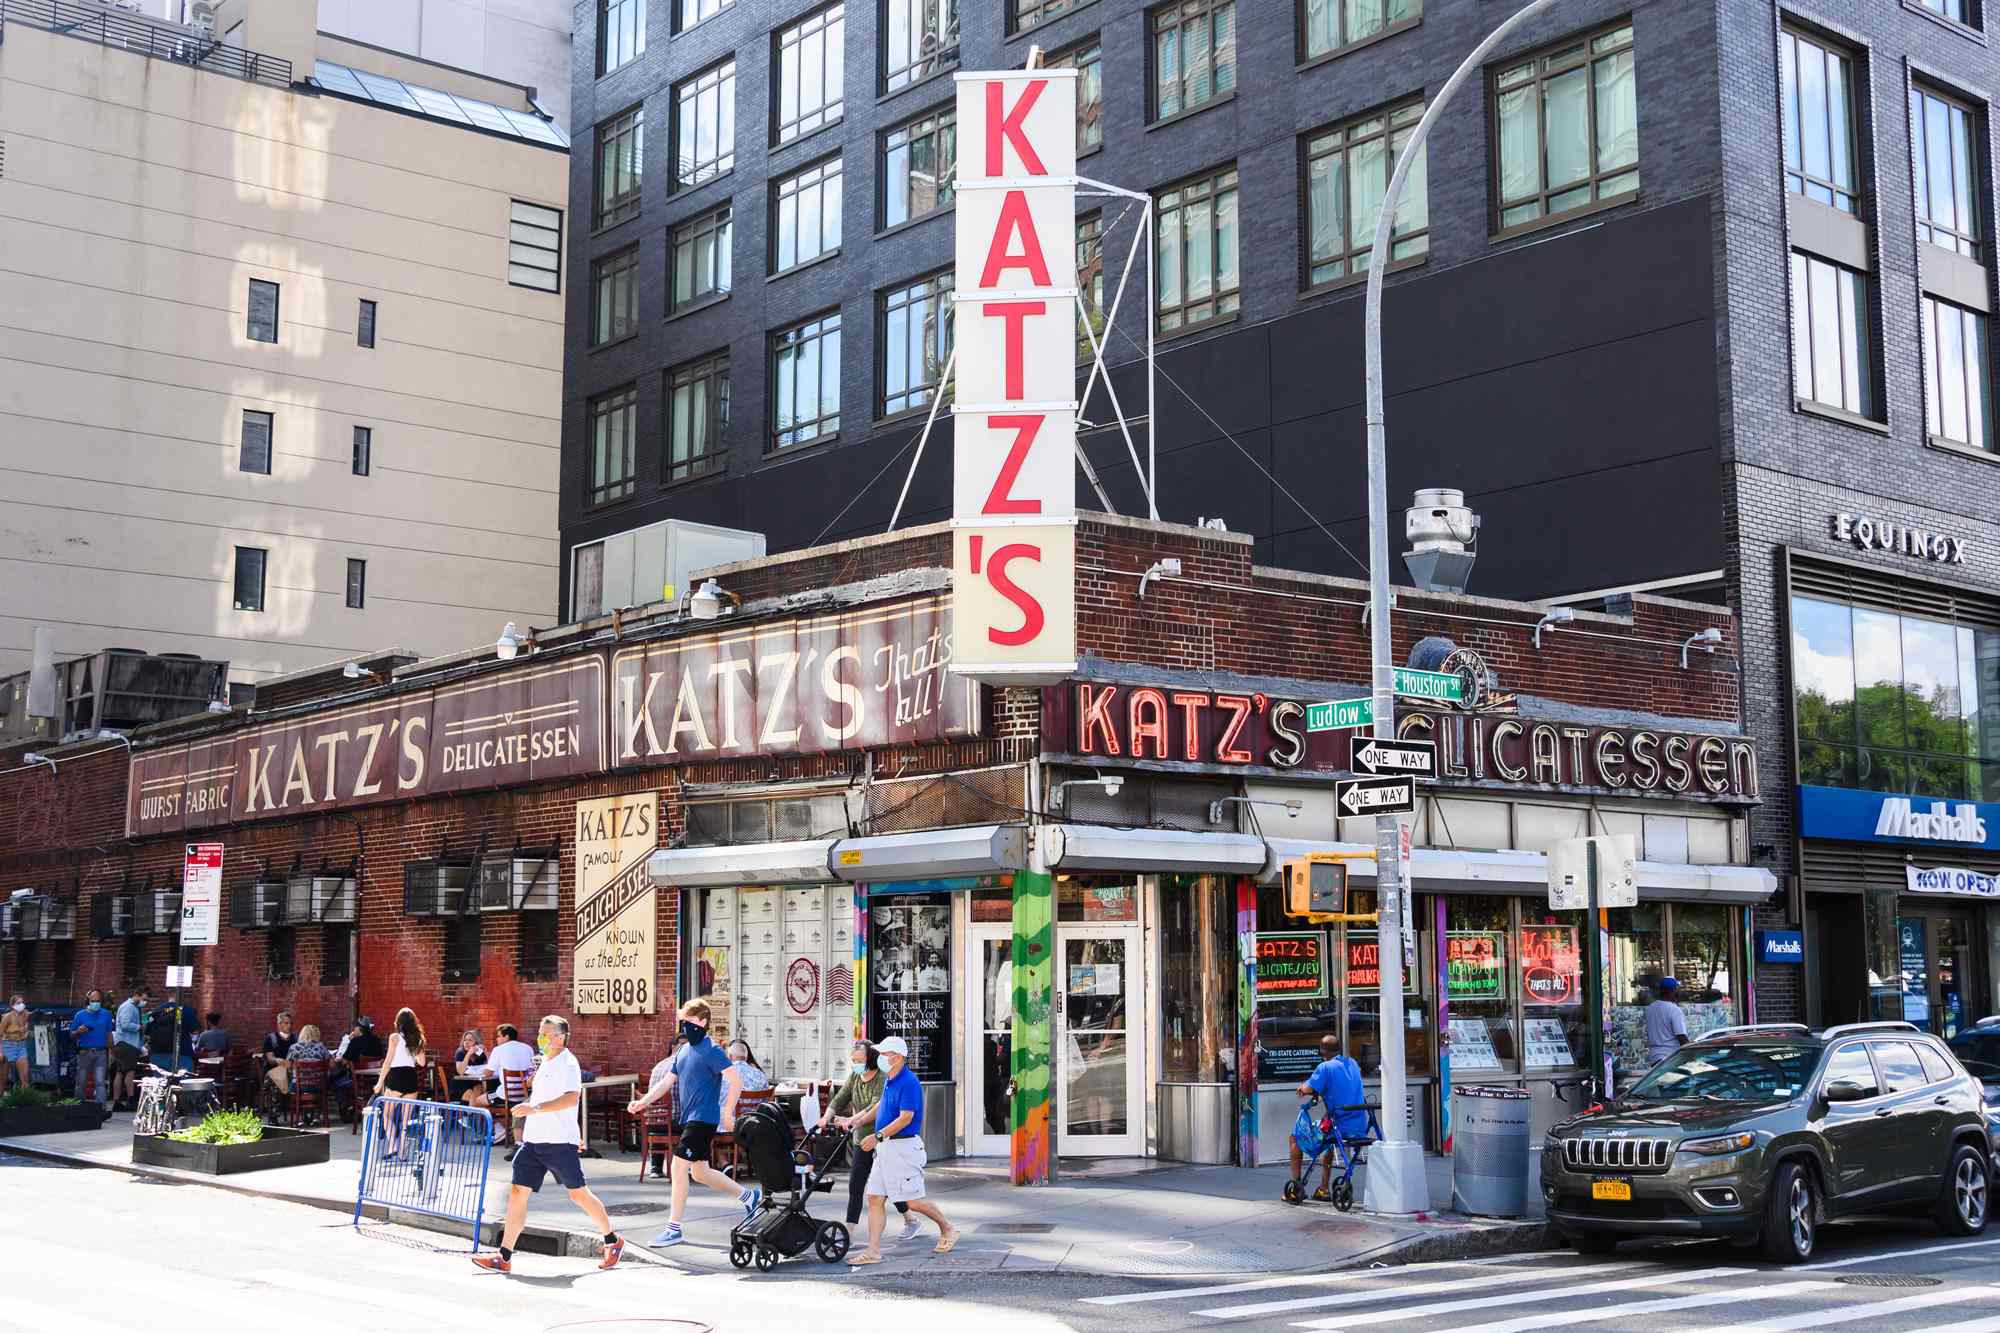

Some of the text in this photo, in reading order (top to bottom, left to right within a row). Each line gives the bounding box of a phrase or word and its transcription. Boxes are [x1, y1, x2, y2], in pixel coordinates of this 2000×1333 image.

[969, 80, 1053, 647] KATZ'S
[1835, 512, 1967, 564] EQUINOX
[1403, 671, 1448, 697] Houston
[1451, 678, 1459, 691] St
[620, 645, 866, 760] KATZ'S
[1309, 700, 1373, 730] Ludlow St
[1080, 684, 1306, 769] KATZ'S
[139, 715, 580, 821] WURST FABRIC KATZ'S DELICATESSEN
[1365, 750, 1425, 767] ONE WAY
[1348, 788, 1404, 807] ONE WAY
[579, 804, 652, 842] KATZ'S
[1875, 798, 1987, 843] Marshalls
[1917, 871, 1997, 893] NOW OPEN
[605, 929, 646, 945] KNOWN
[1766, 940, 1801, 953] Marshalls
[584, 956, 596, 969] as
[597, 949, 614, 968] the
[578, 987, 605, 1005] SINCE
[880, 999, 945, 1010] The Real Taste
[882, 1010, 894, 1021] of
[895, 1010, 915, 1020] New
[886, 1020, 913, 1030] Since
